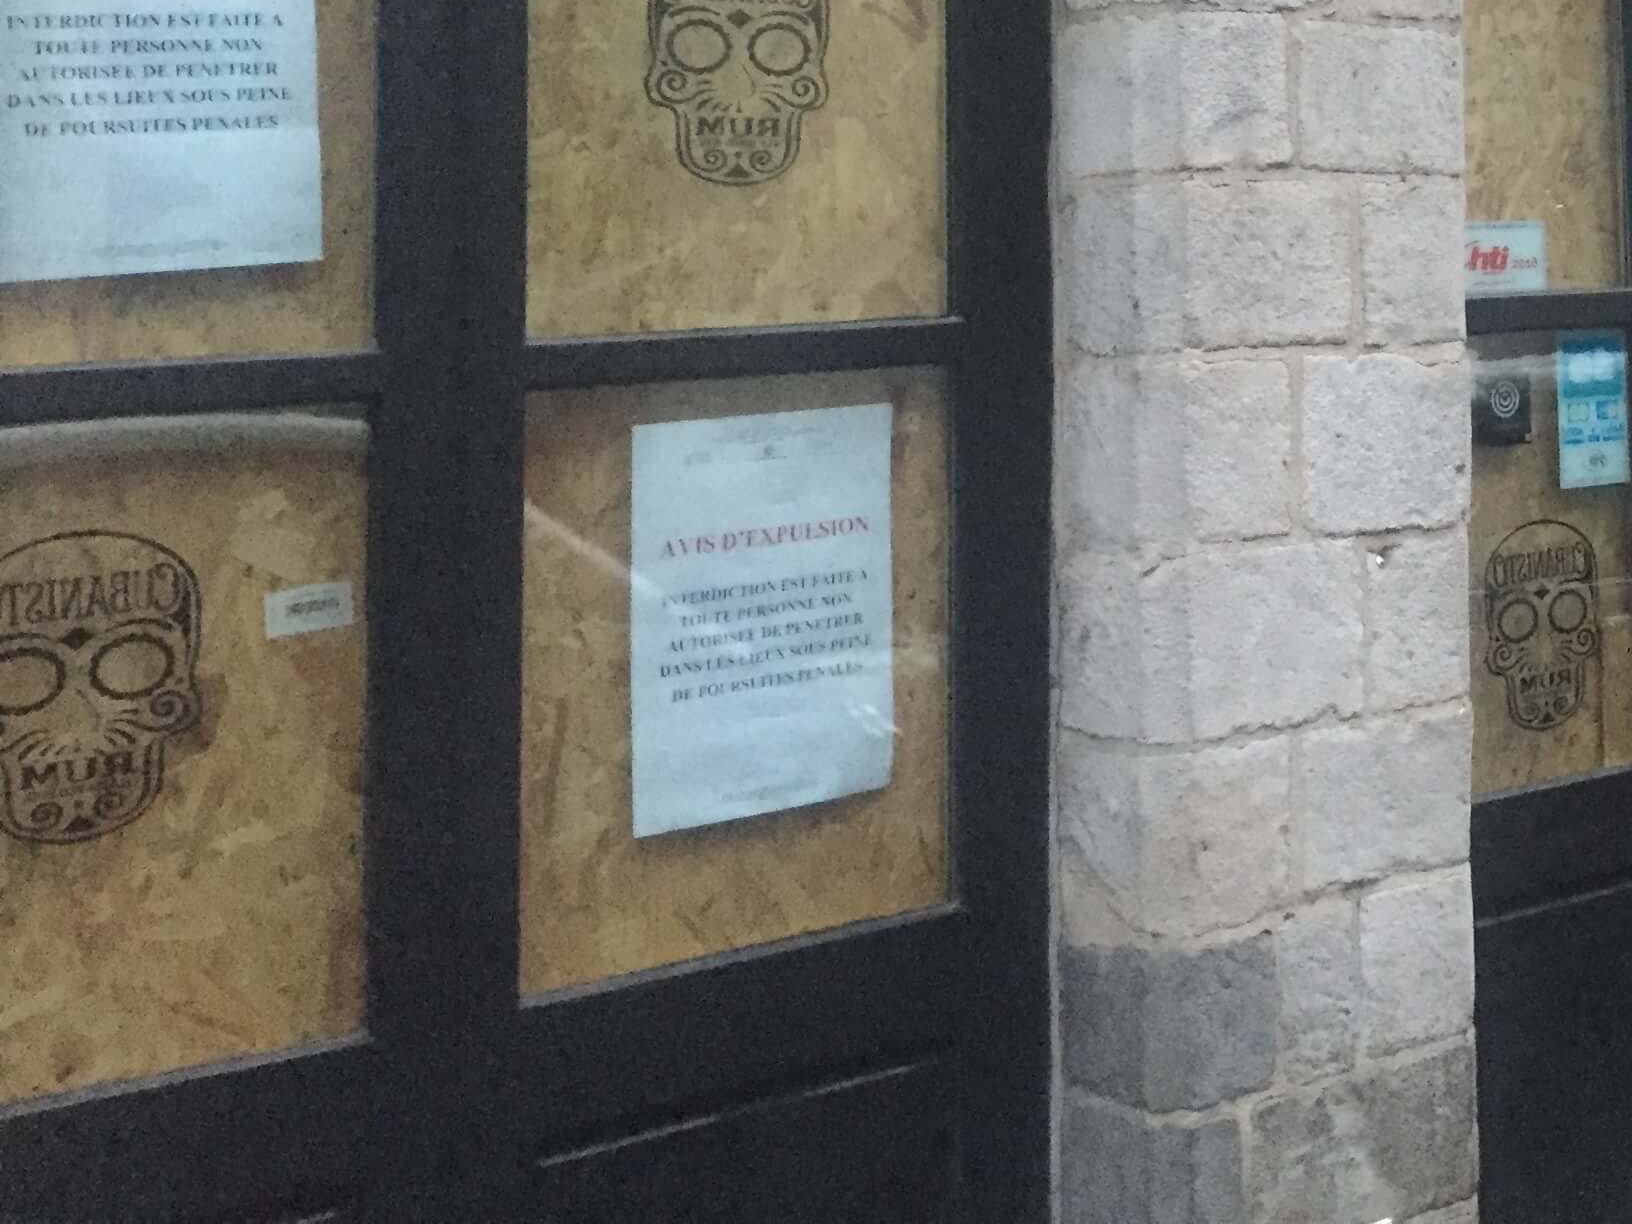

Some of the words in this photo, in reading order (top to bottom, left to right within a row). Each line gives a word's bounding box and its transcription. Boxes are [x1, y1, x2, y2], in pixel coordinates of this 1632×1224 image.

[208, 11, 264, 27] FAITE
[110, 38, 212, 54] PERSONNE
[221, 37, 264, 52] NON
[143, 63, 168, 79] DE
[24, 122, 50, 138] DE
[660, 536, 716, 559] AVIS
[722, 515, 871, 553] D'EXPULSION
[820, 591, 854, 608] NON
